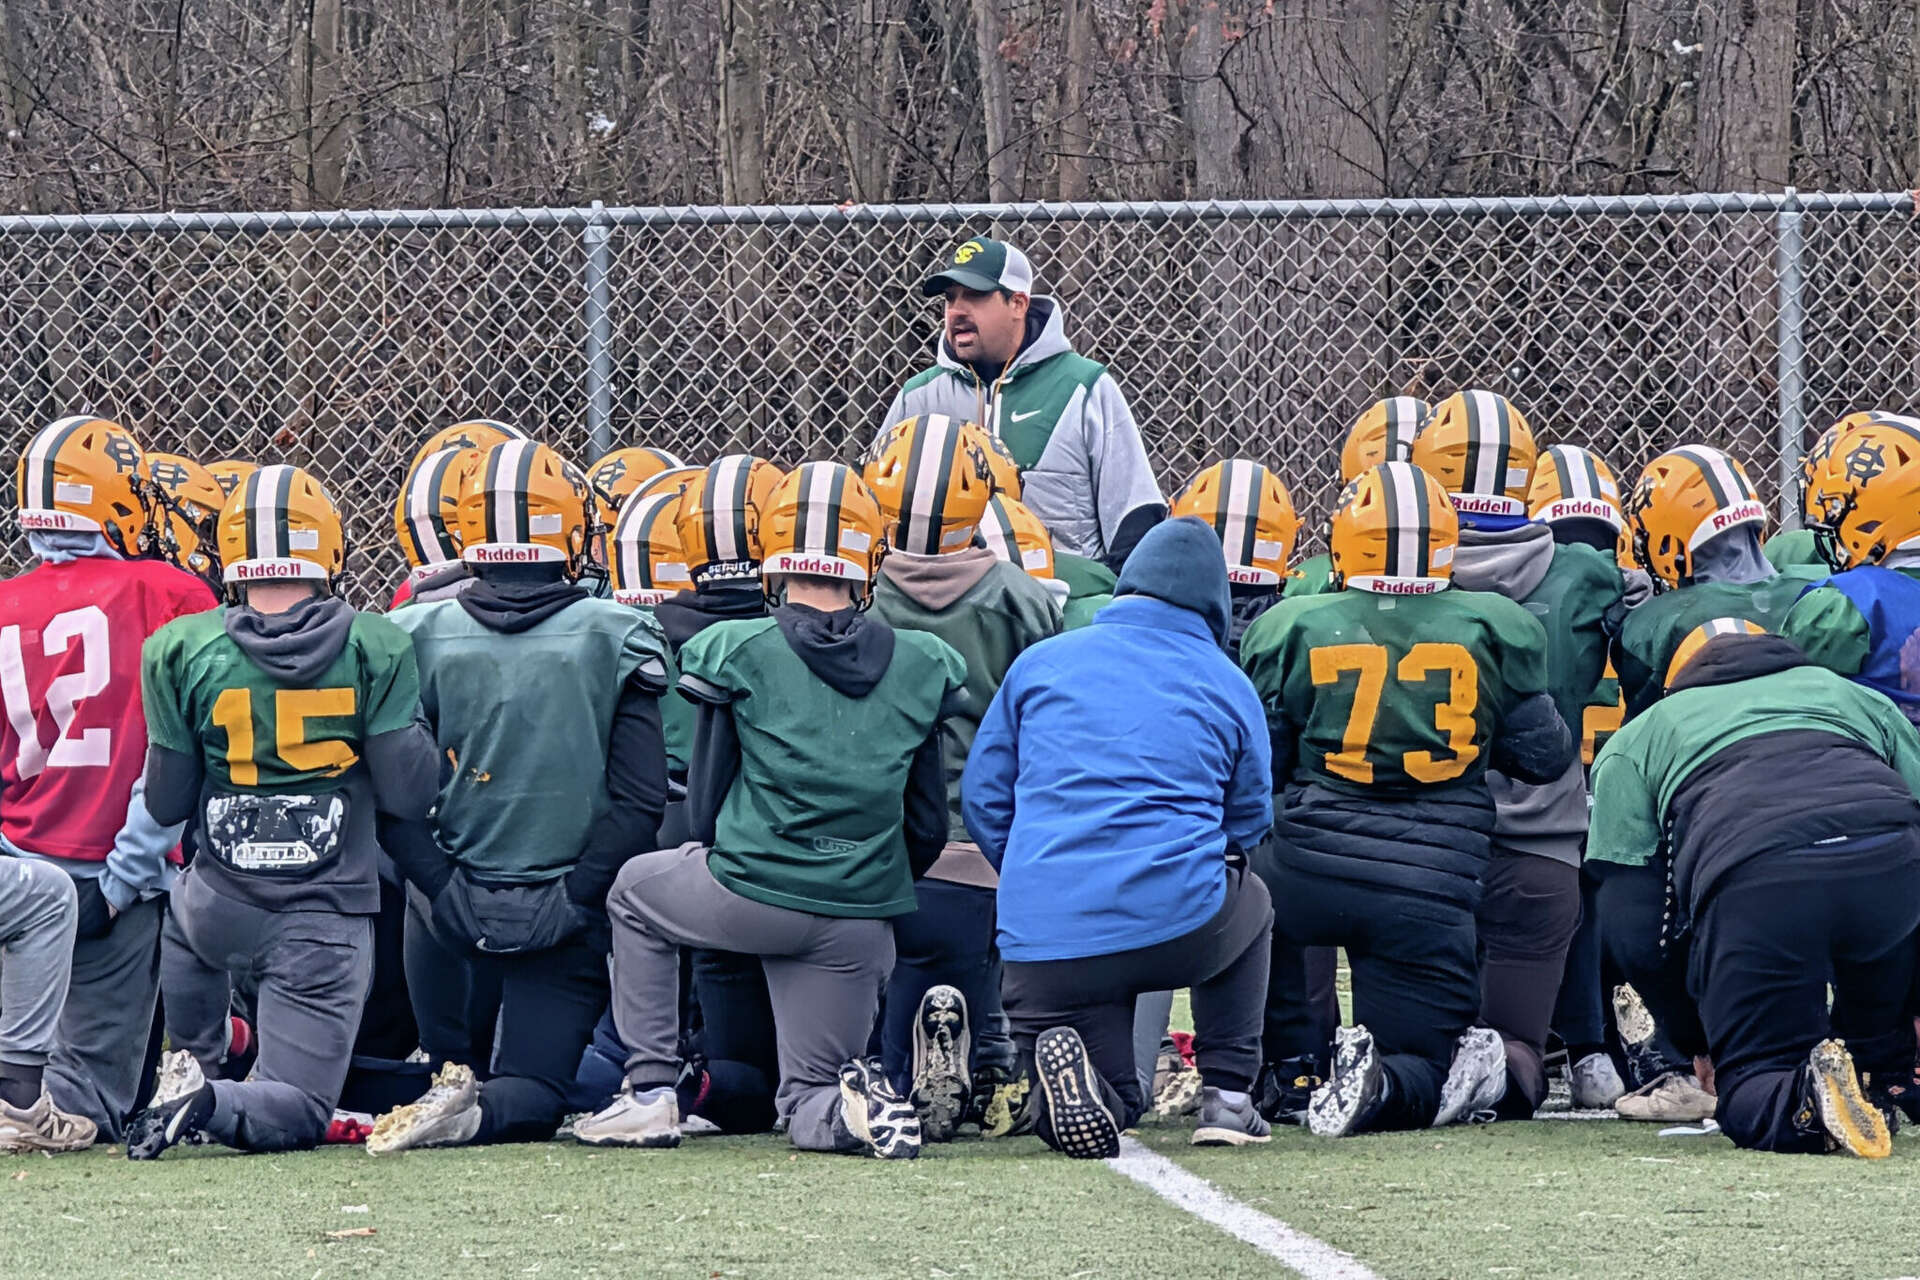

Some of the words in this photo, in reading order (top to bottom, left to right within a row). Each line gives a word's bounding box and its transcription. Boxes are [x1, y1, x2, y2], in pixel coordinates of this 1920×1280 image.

[1552, 501, 1611, 519] Riddell
[475, 548, 540, 561] Riddell
[237, 563, 302, 578] Riddell
[780, 557, 845, 576] Riddell
[1372, 580, 1436, 594] Riddell
[0, 605, 111, 782] 12
[1309, 643, 1480, 783] 73
[212, 687, 360, 786] 15
